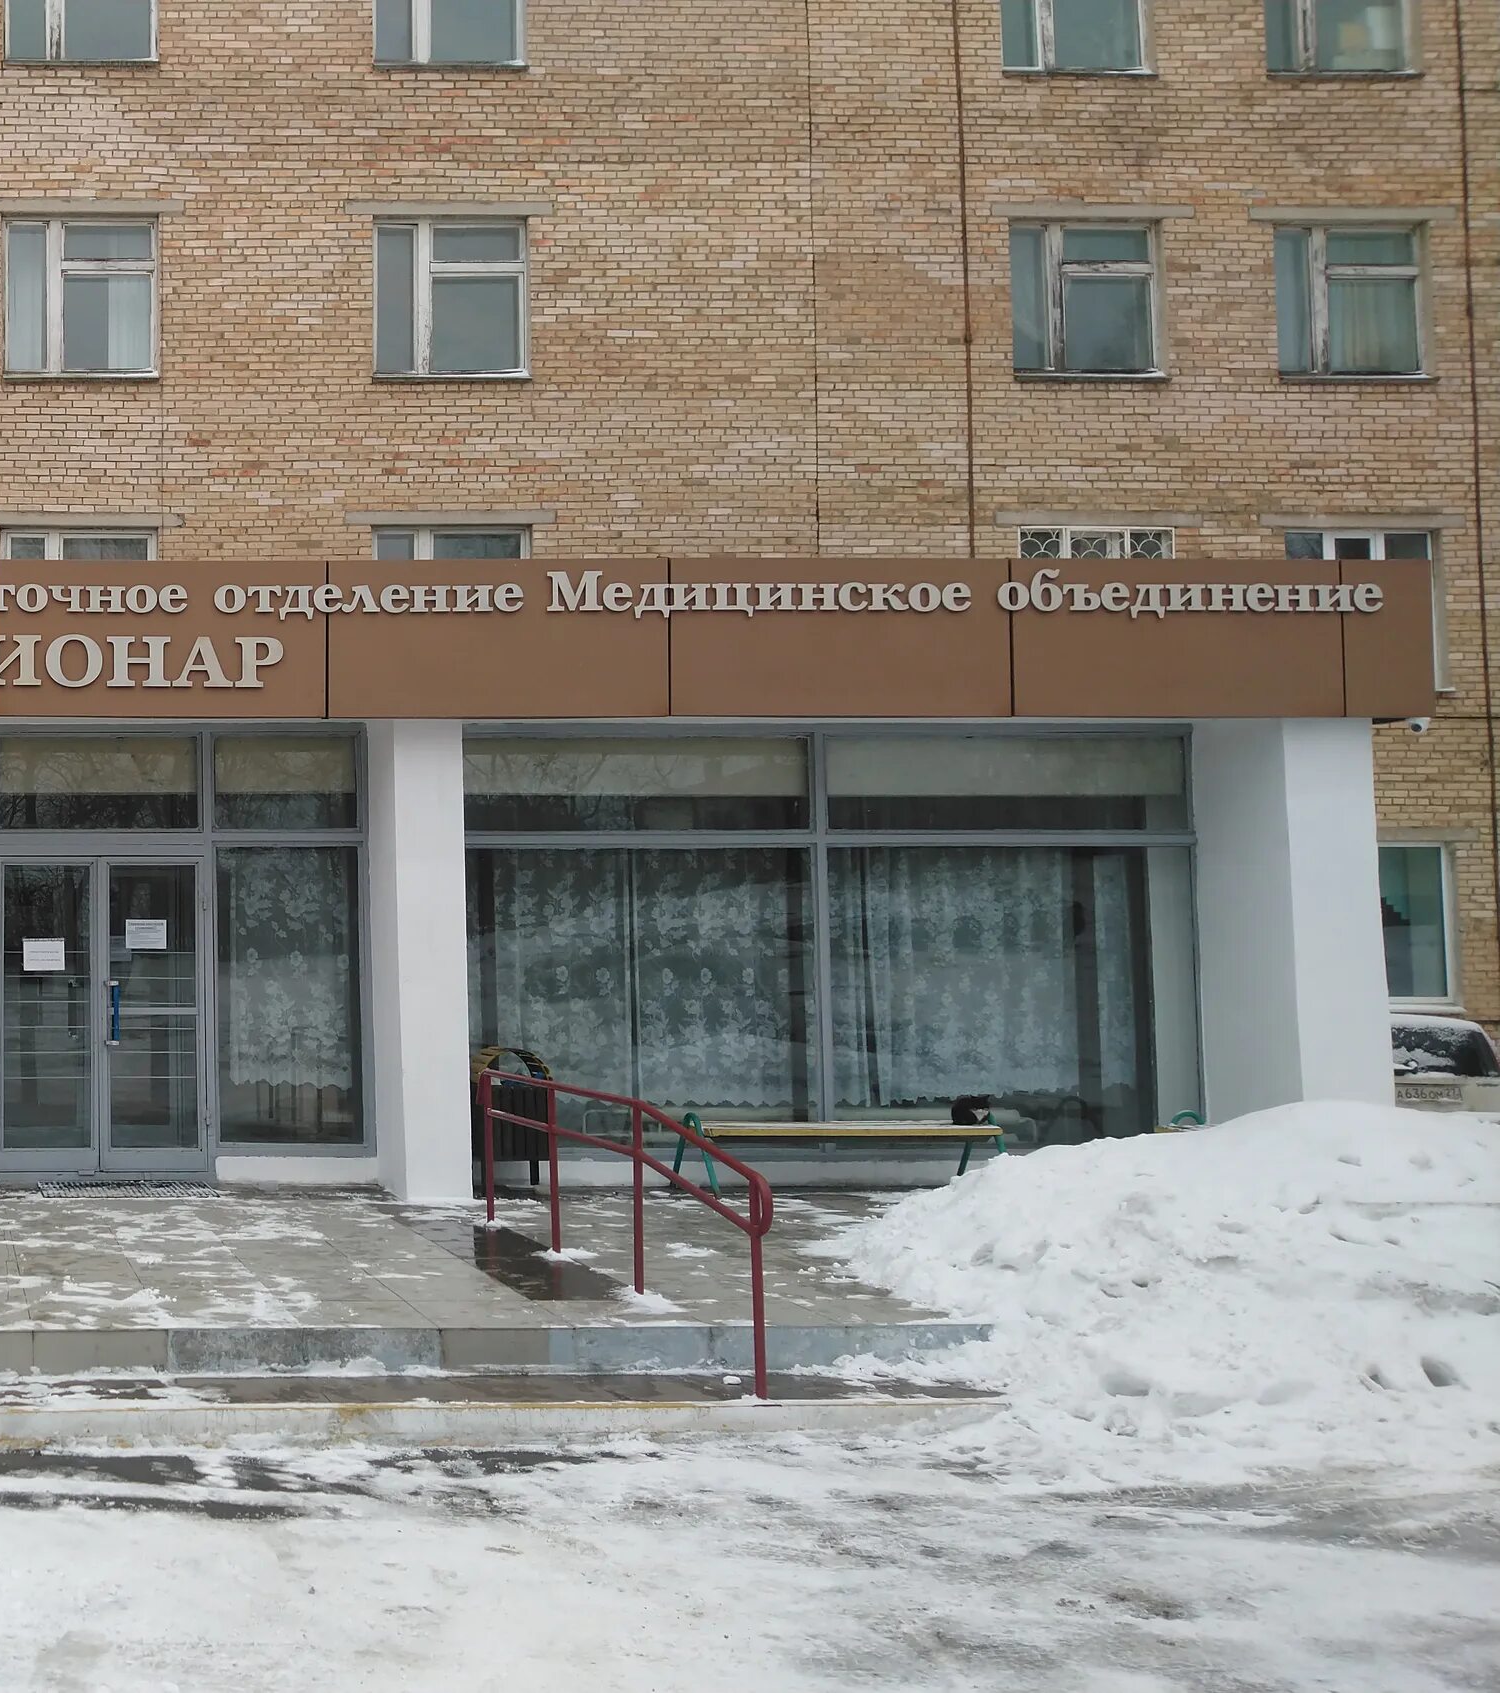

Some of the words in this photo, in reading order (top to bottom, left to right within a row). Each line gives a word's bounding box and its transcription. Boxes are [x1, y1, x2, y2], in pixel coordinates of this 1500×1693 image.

[214, 583, 524, 620] отделение
[547, 570, 972, 618] Медицинское
[997, 569, 1384, 618] объединение
